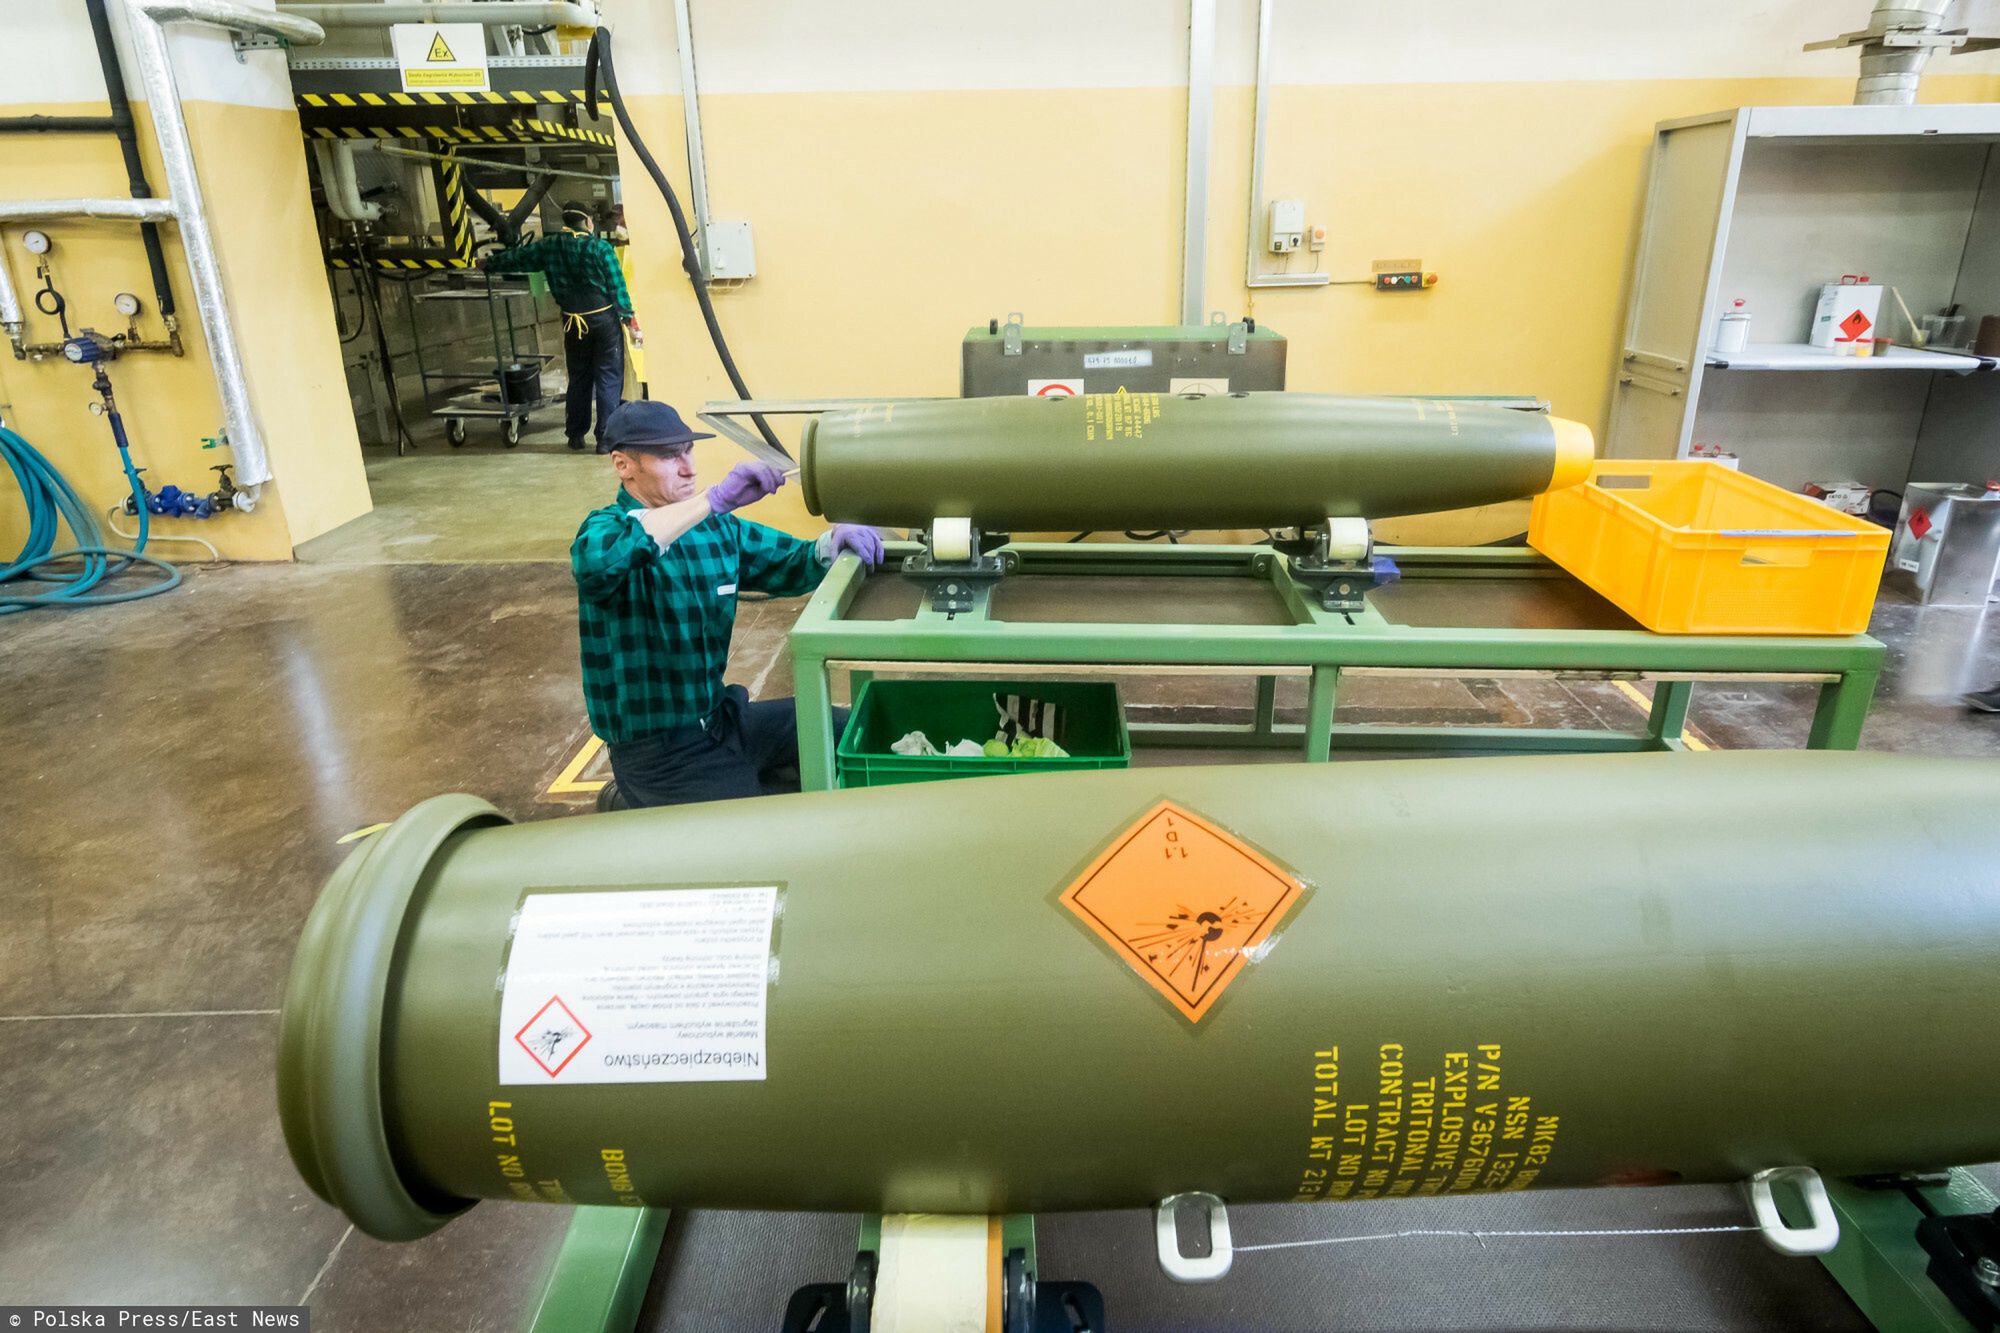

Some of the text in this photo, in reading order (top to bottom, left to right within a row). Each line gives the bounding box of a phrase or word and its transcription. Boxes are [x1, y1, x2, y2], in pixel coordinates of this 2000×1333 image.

[434, 47, 449, 58] Ex
[1164, 847, 1188, 859] 1.1
[1166, 831, 1177, 842] D
[604, 1049, 759, 1070] Niebezpieczeństwo
[1477, 1044, 1501, 1090] P/N
[1313, 1046, 1338, 1127] TOTAL
[1371, 1043, 1403, 1163] CONTRACT
[1343, 1104, 1369, 1146] LOT
[1398, 1077, 1435, 1175] TRITONAL
[1430, 1053, 1468, 1171] EXPLOSIVE
[1502, 1096, 1531, 1140] NSN
[489, 1101, 524, 1178] LOT NO
[1309, 1136, 1334, 1160] WT
[1336, 1154, 1362, 1175] NO
[1363, 1169, 1392, 1186] NO
